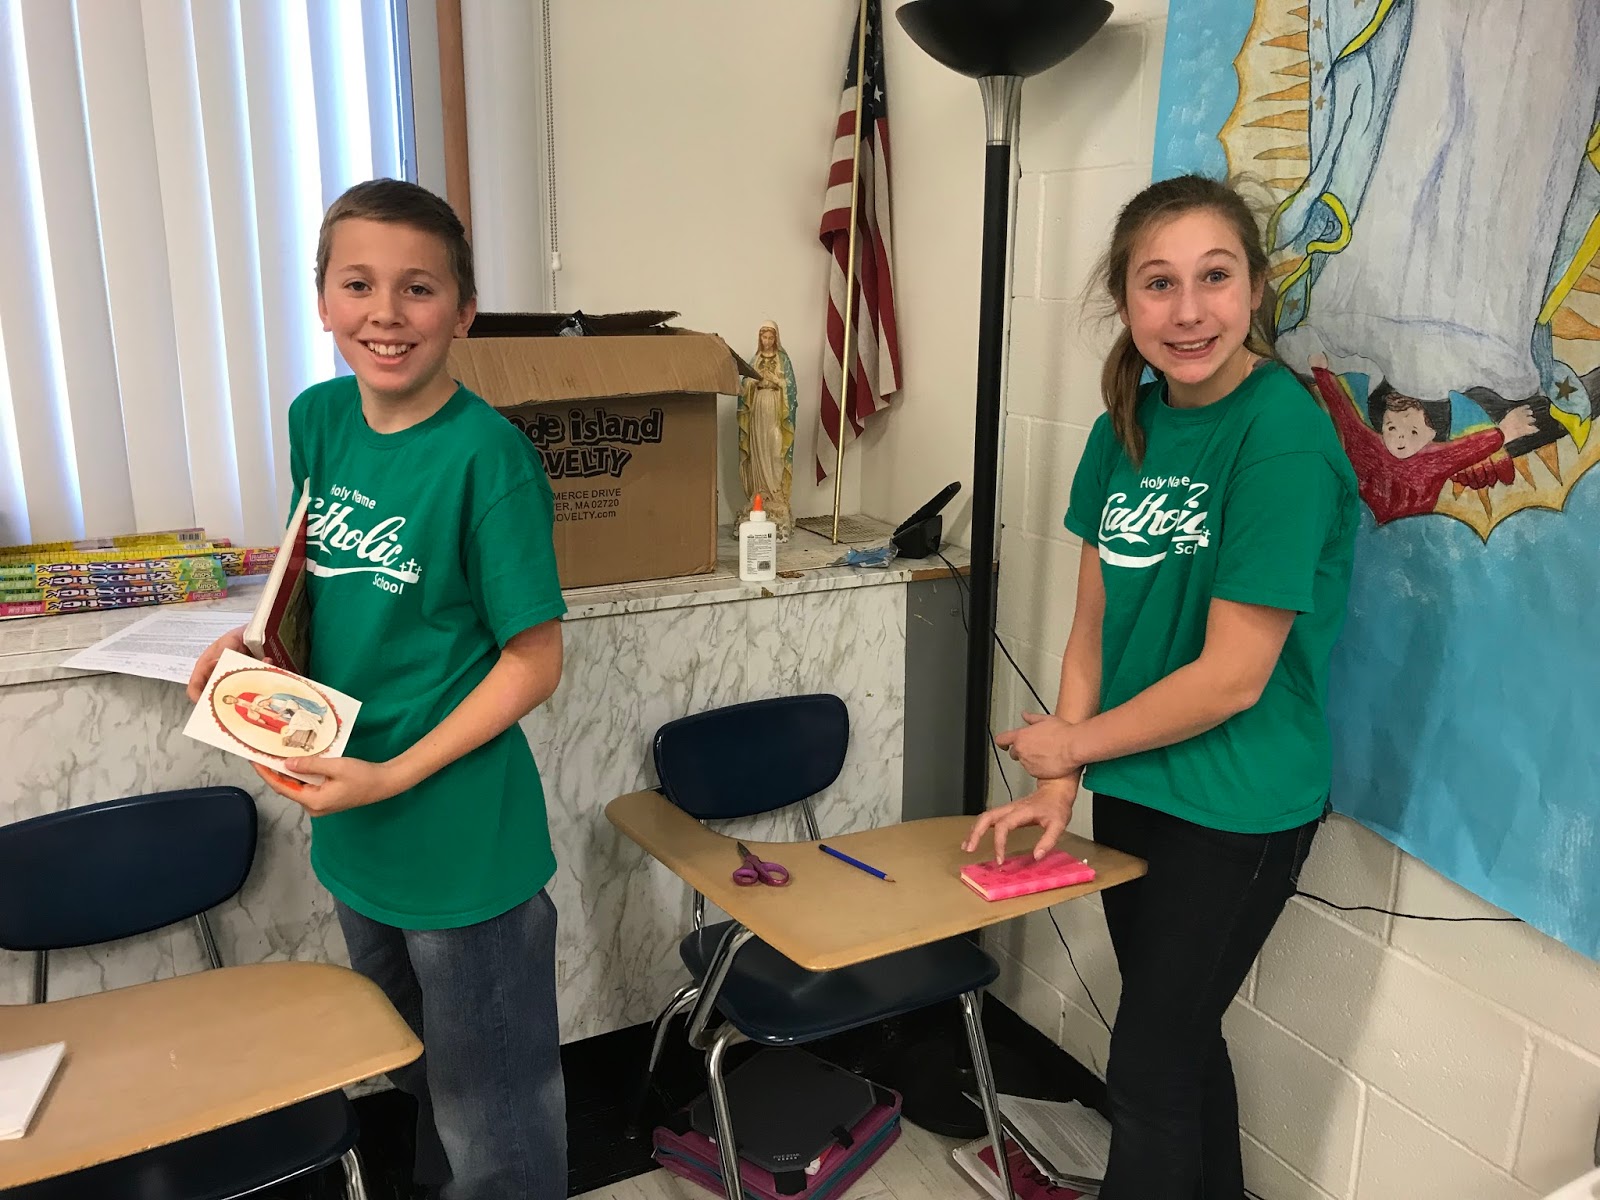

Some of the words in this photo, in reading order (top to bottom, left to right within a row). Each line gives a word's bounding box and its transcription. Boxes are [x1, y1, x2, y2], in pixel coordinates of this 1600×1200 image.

[568, 407, 664, 446] island
[534, 445, 632, 479] VELTY
[591, 488, 622, 499] DRIVE
[1140, 476, 1167, 490] Holy
[1167, 475, 1190, 488] Nae
[330, 484, 352, 501] Holy
[352, 489, 376, 509] Name
[575, 501, 590, 510] MA
[591, 498, 620, 509] 02720
[372, 573, 404, 595] School
